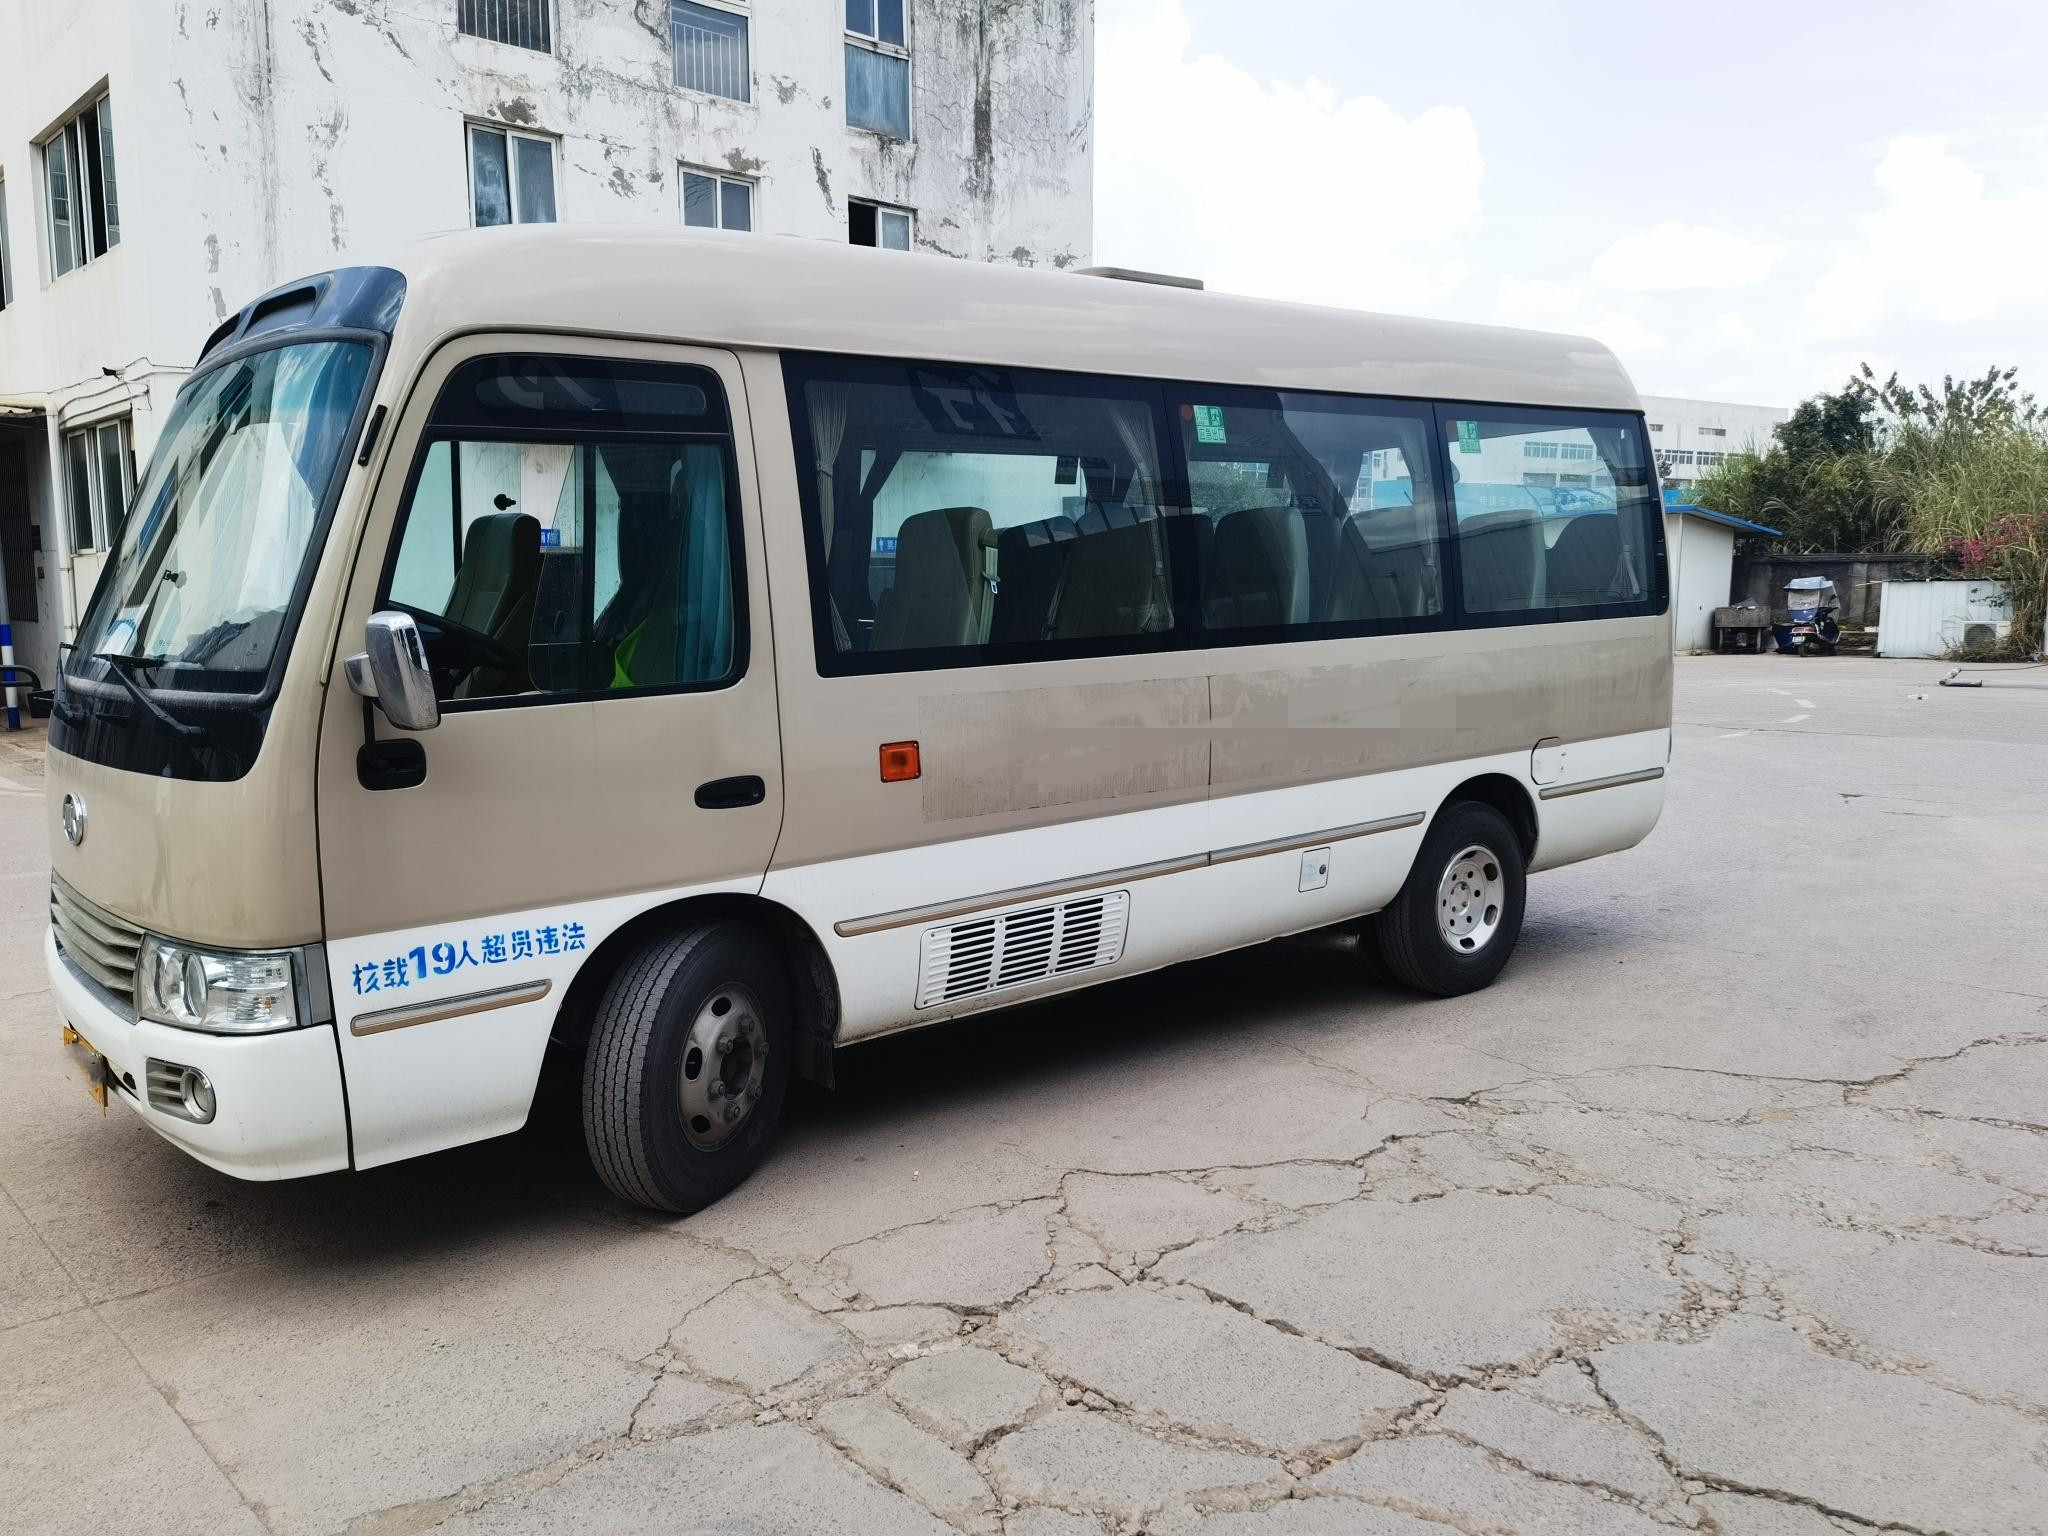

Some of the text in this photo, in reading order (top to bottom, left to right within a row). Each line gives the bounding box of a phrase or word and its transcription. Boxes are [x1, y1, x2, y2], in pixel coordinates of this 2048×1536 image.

[352, 922, 586, 995] 核载19人超员违法
